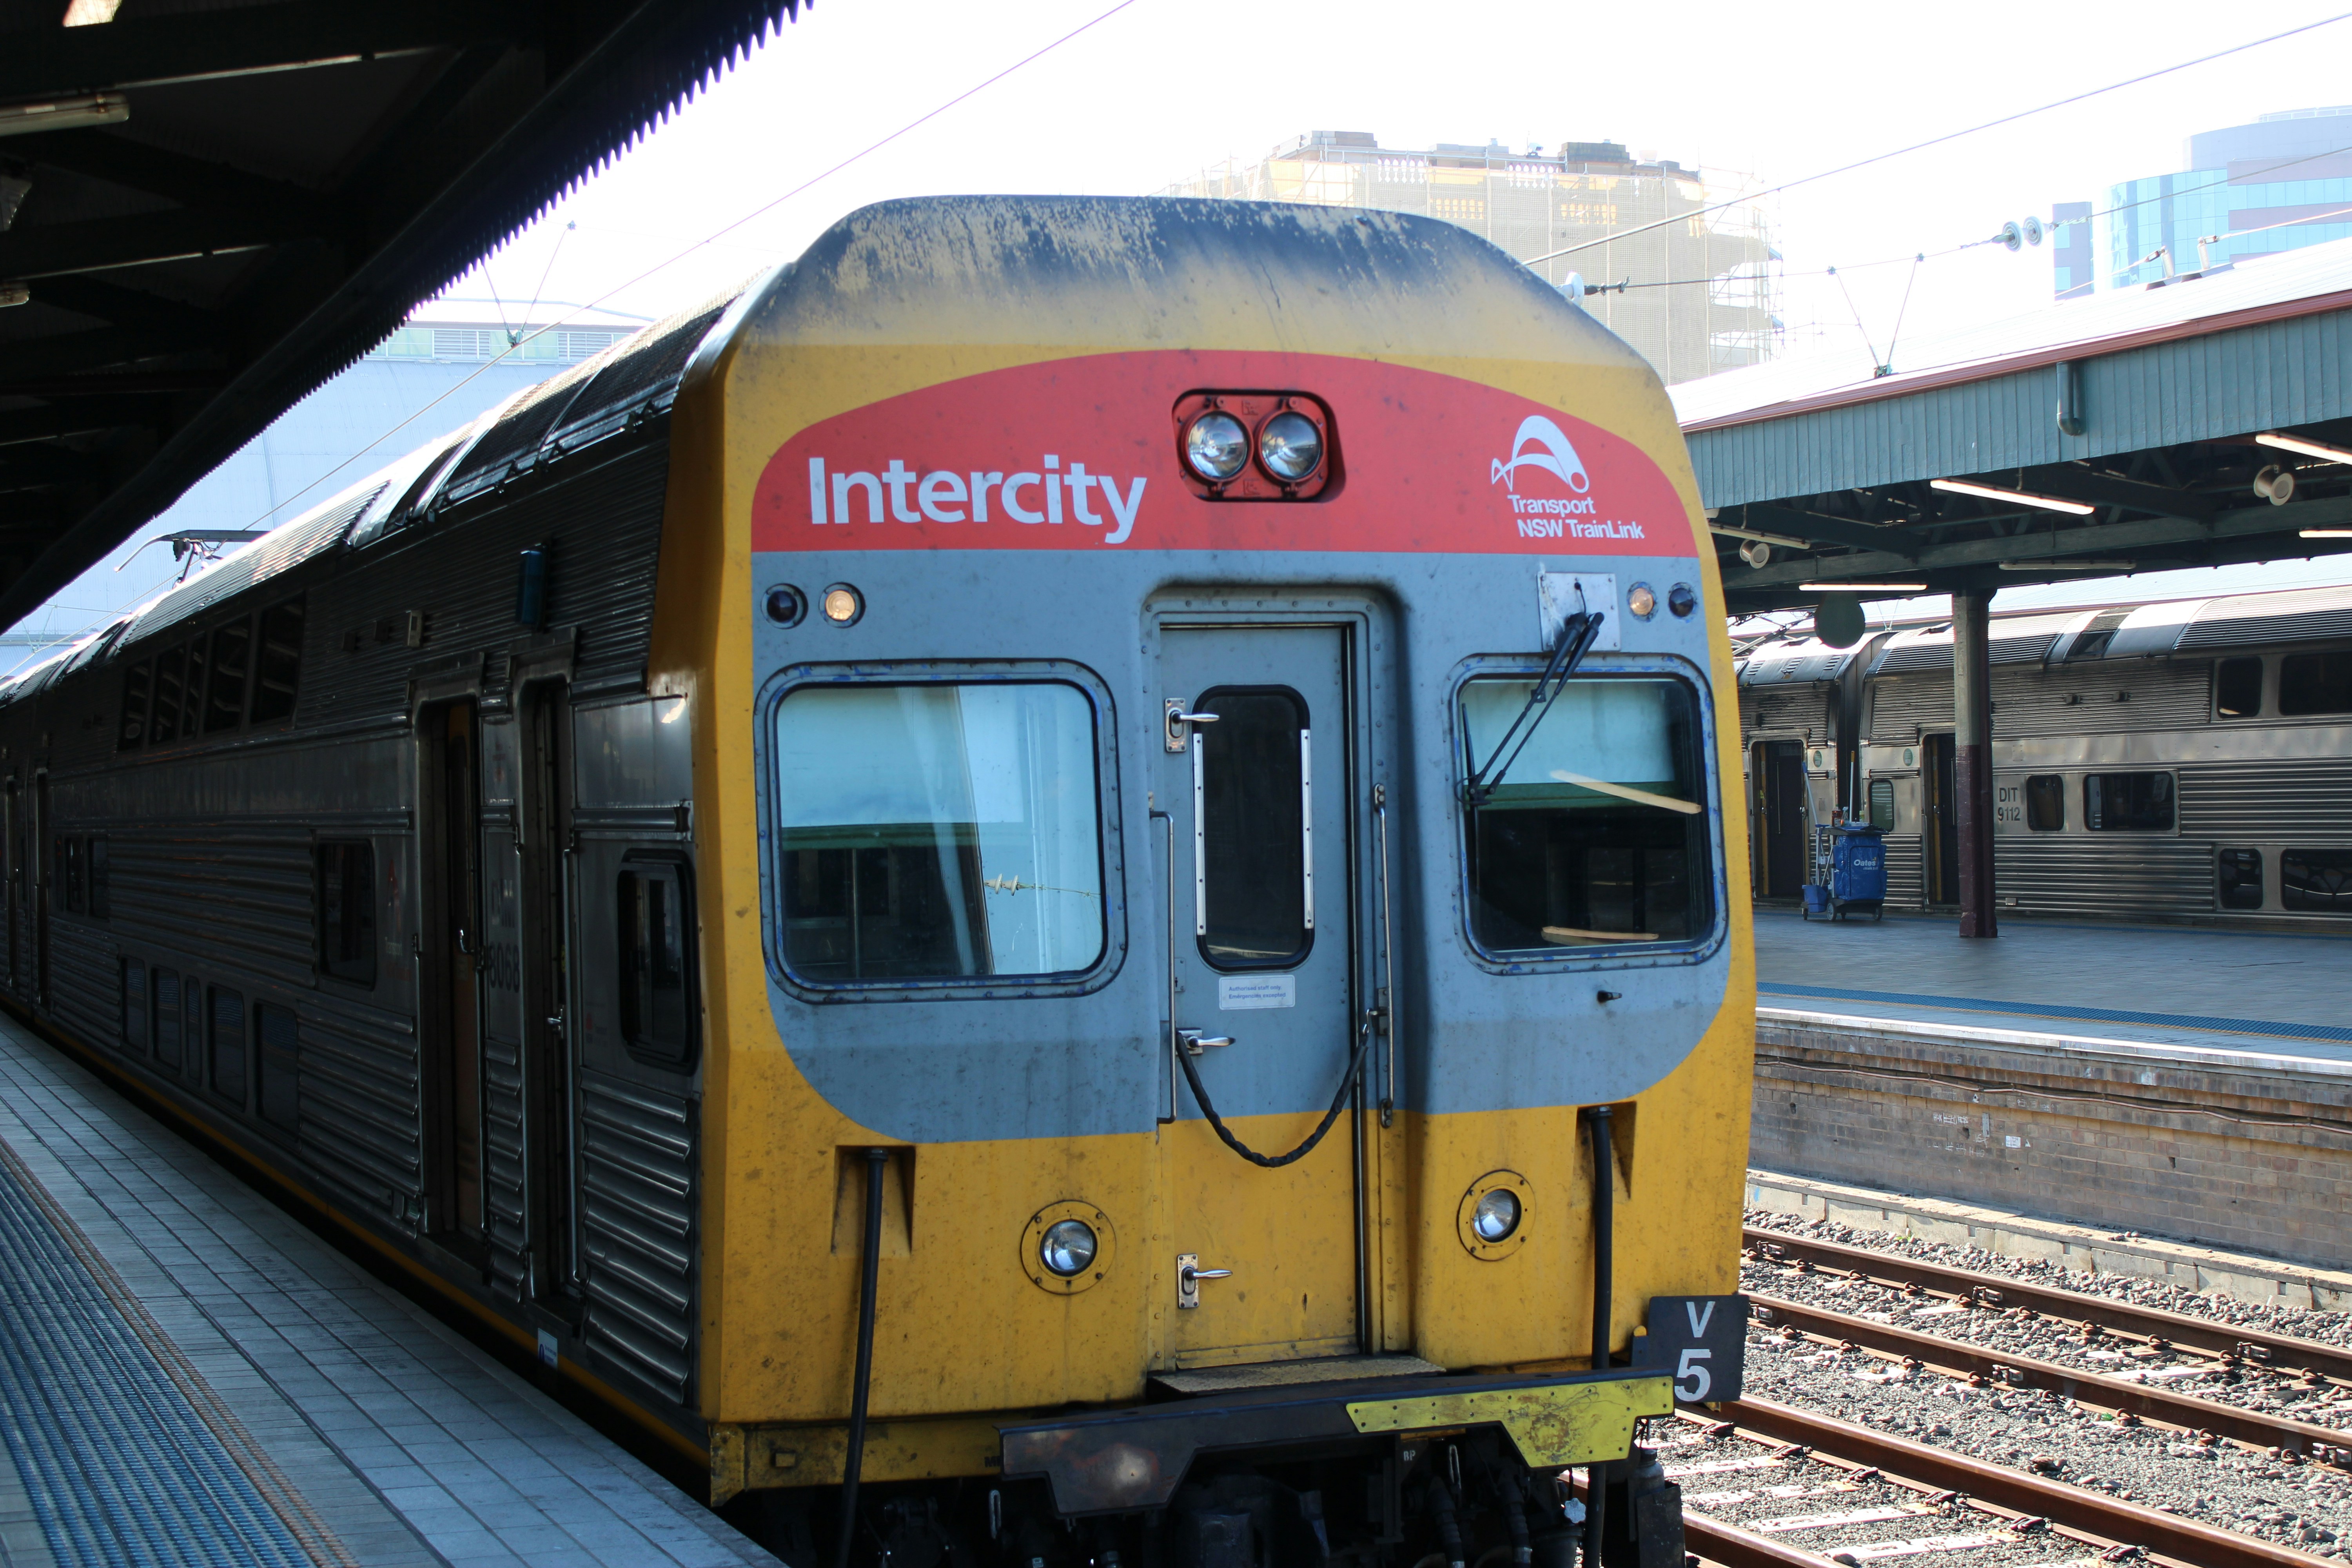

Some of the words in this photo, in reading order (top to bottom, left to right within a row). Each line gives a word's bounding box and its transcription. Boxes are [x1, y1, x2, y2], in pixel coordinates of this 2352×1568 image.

[809, 454, 1147, 544] Intercity
[1507, 495, 1596, 517] Transport
[1517, 519, 1563, 538] NSW
[1566, 519, 1645, 539] TrainLink
[1999, 787, 2018, 802] DIT
[1997, 806, 2021, 822] 9112
[489, 941, 521, 993] 8068
[1686, 1301, 1716, 1338] V
[1674, 1348, 1711, 1402] 5
